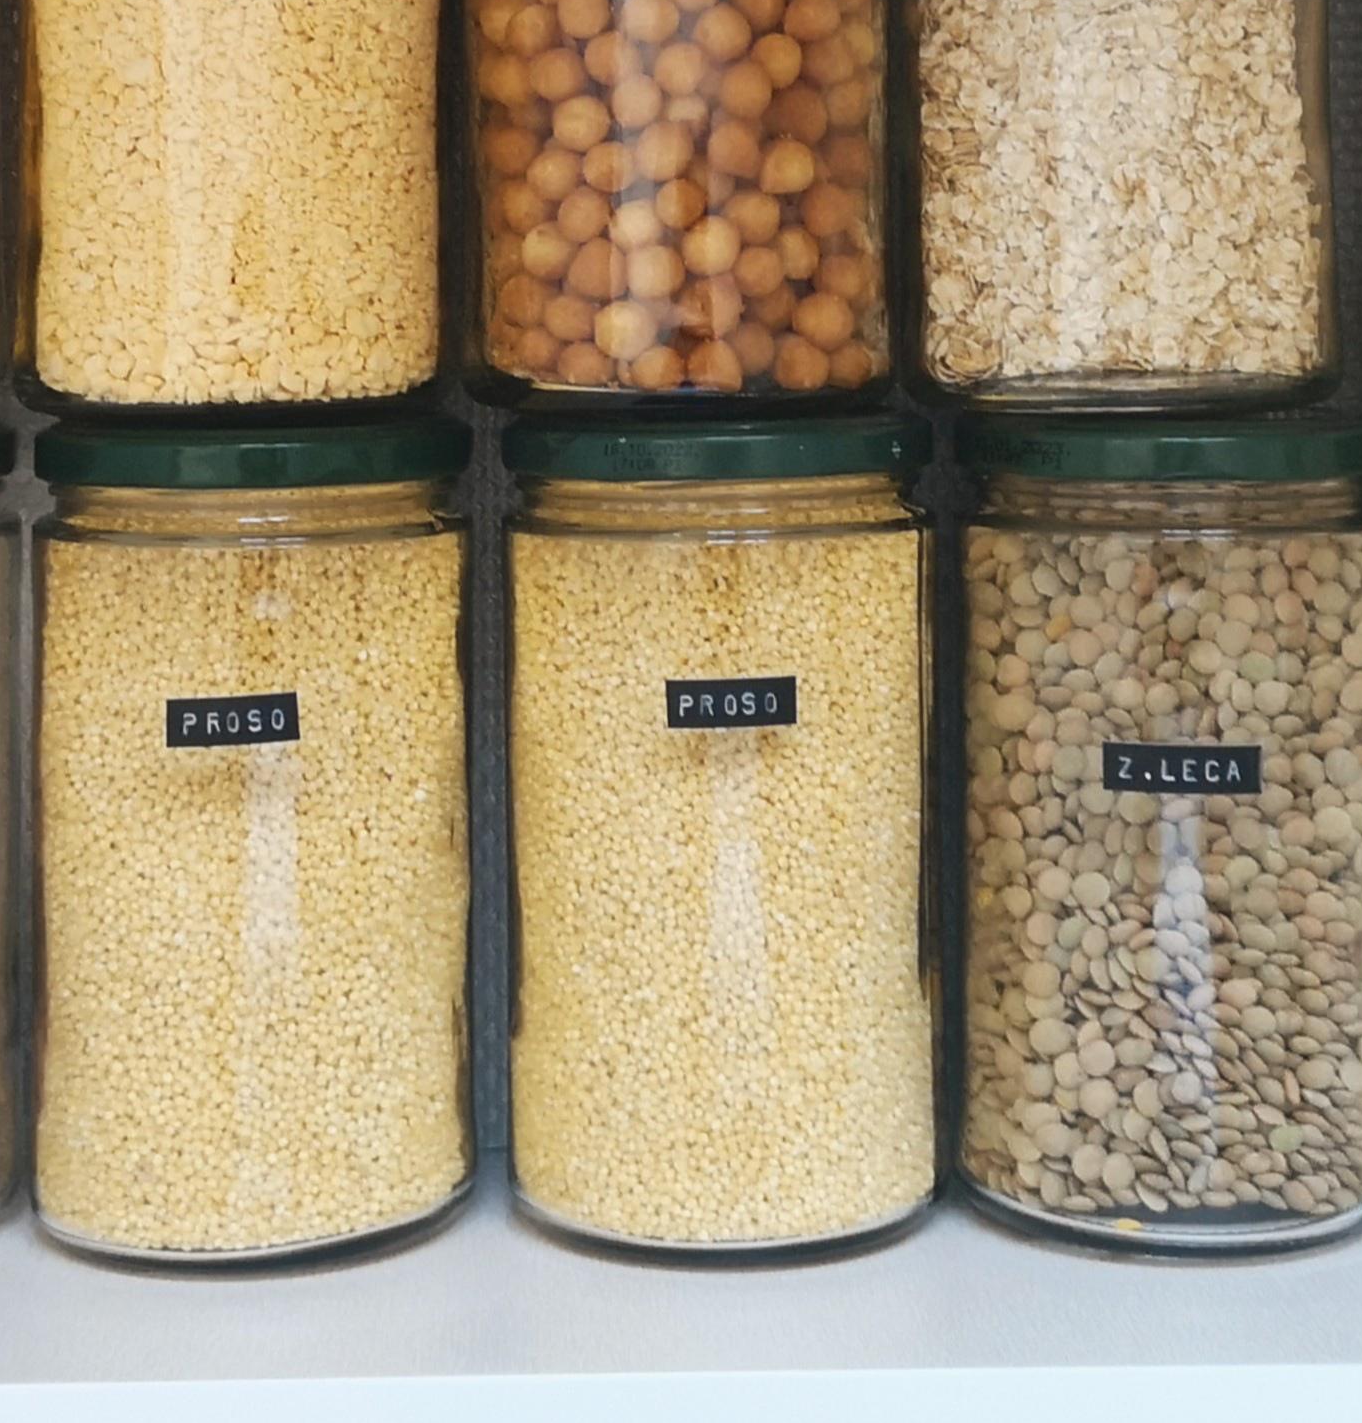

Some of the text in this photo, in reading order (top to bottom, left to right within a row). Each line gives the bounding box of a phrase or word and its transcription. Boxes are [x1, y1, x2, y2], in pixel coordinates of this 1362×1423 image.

[678, 692, 778, 717] PROSO
[182, 708, 285, 736] PROSO
[1118, 756, 1242, 784] Z.LECA
